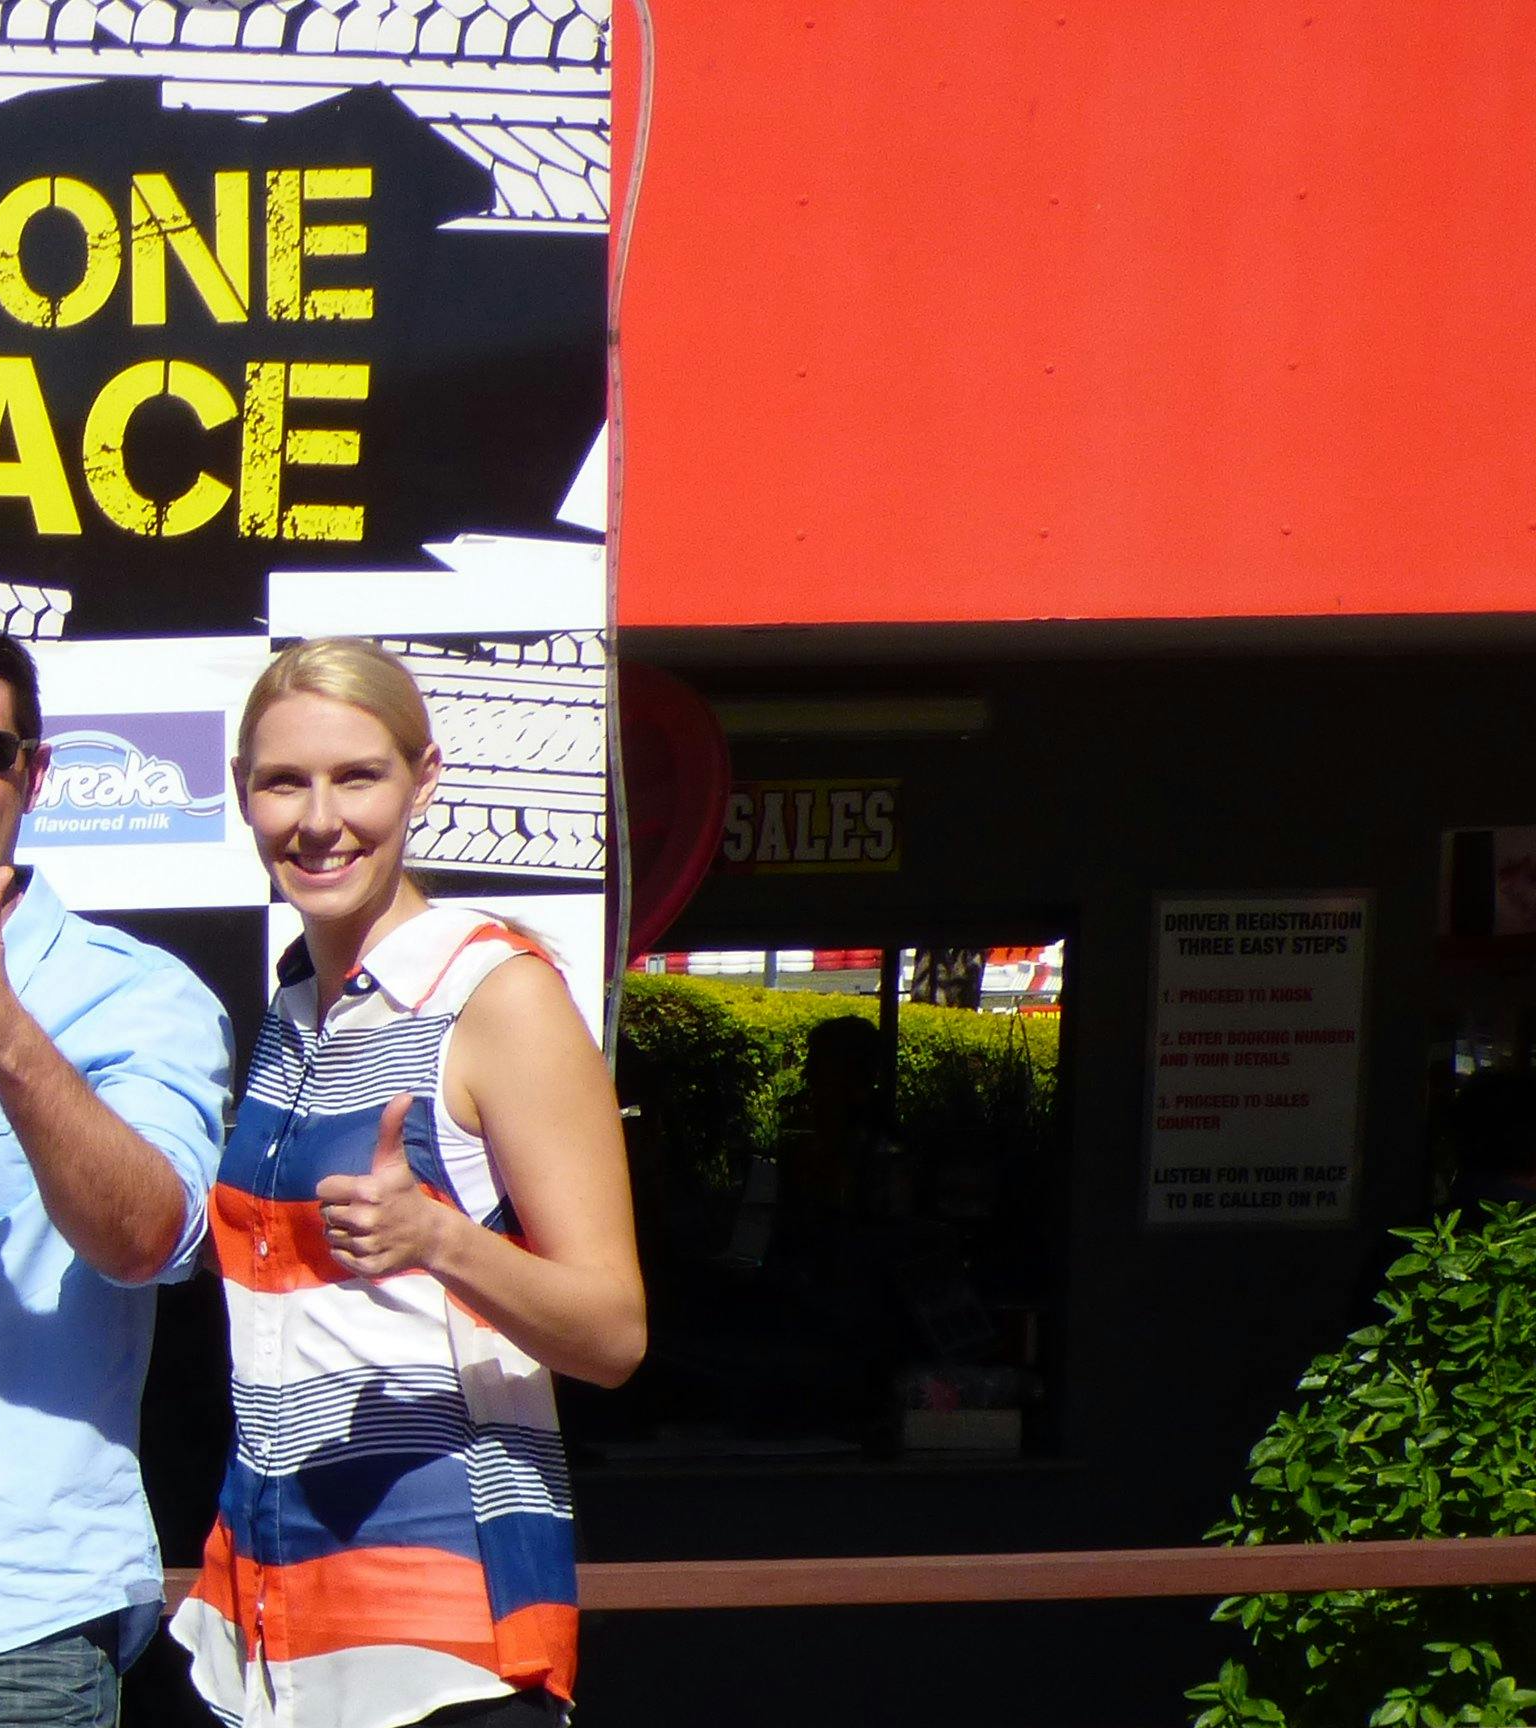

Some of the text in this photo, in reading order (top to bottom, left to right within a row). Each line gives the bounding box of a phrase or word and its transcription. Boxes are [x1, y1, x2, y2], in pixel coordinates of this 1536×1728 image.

[34, 748, 193, 808] reaka
[34, 813, 171, 833] flavoured milk
[722, 789, 898, 864] SALES
[1164, 911, 1362, 932] DRIVER REGISTRATION
[1178, 936, 1348, 955] THREE EASY STEPS
[1154, 1166, 1348, 1185] LISTEN FOR YOUR RACE
[1166, 1193, 1187, 1210] TO
[1219, 1192, 1282, 1209] CALLED
